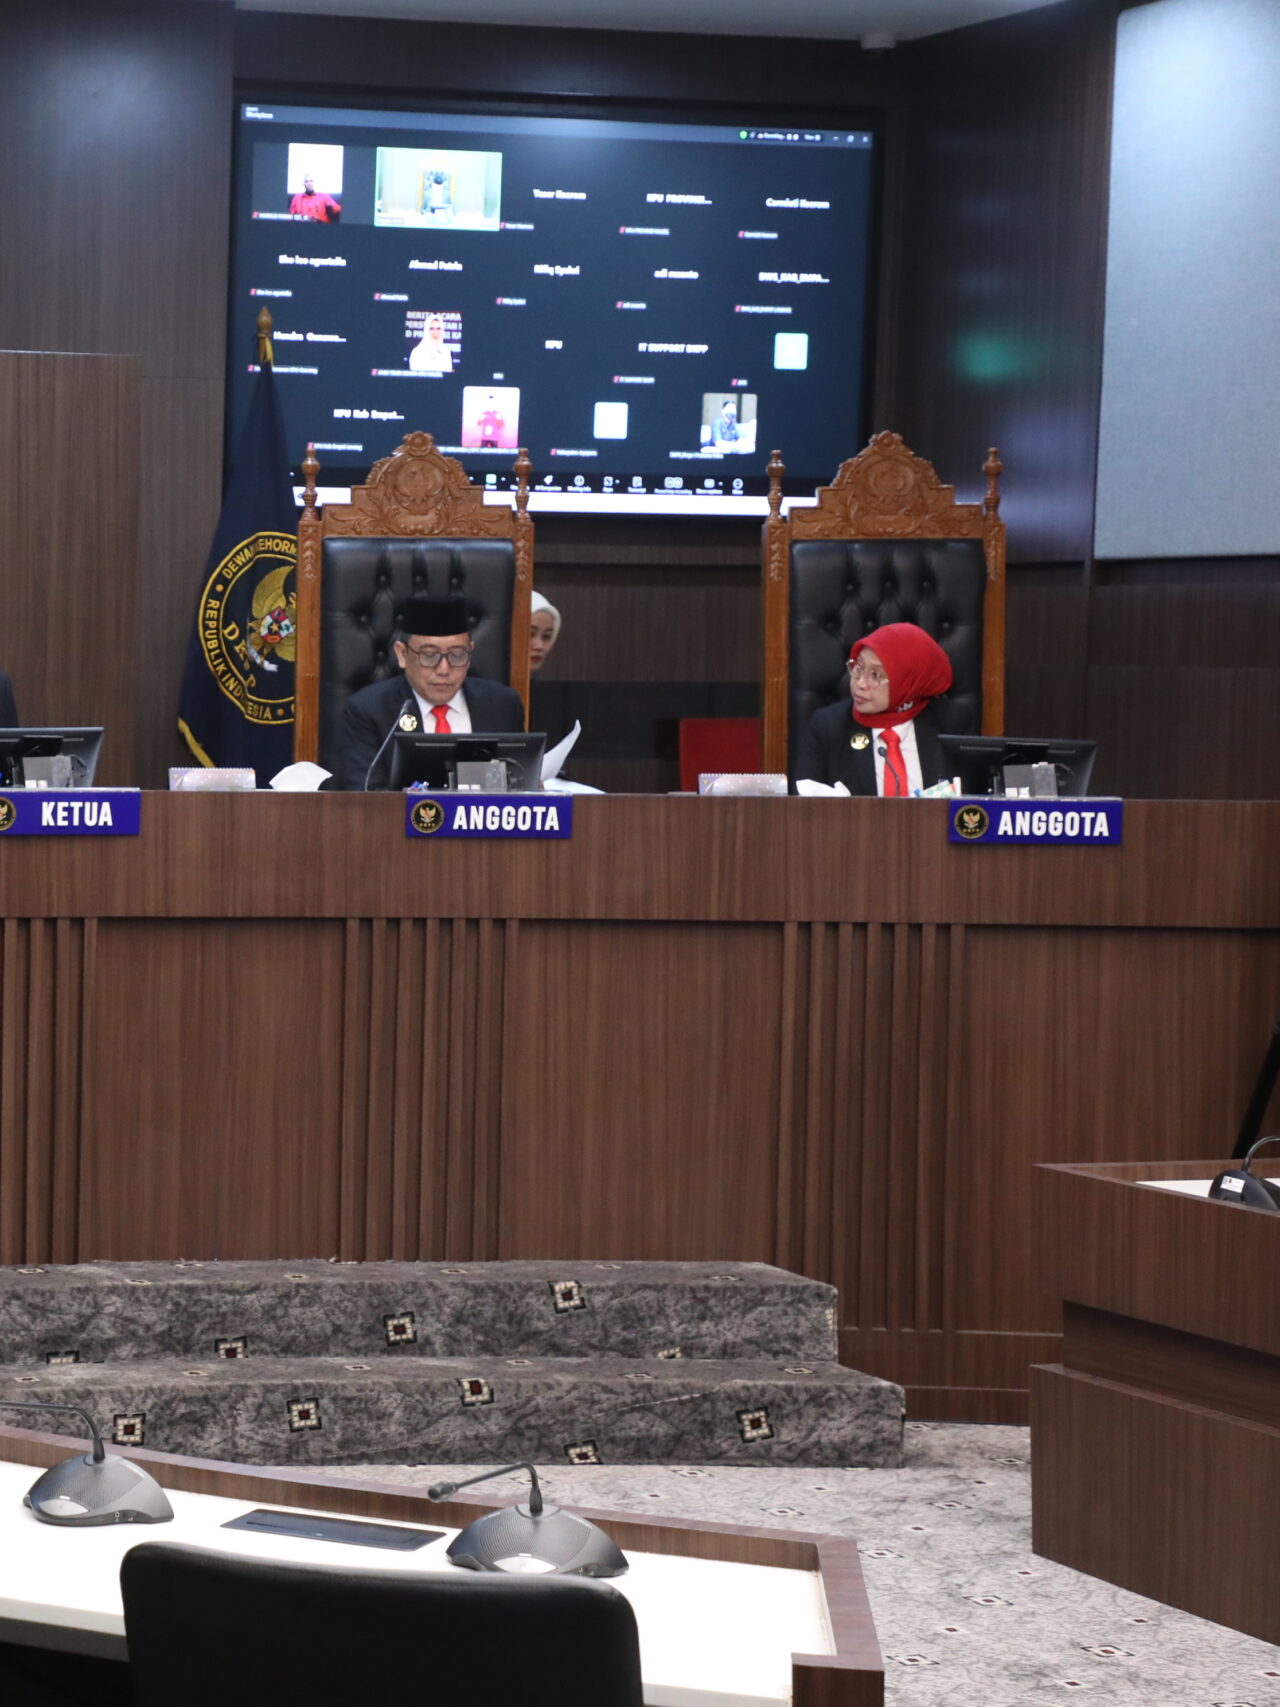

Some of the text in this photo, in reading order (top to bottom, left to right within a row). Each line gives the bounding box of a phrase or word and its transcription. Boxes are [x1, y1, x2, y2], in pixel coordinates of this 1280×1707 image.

[204, 599, 273, 720] REPUBLIK INDESIA
[41, 801, 114, 827] KETUA
[453, 805, 560, 831] ANGGOTA
[997, 811, 1109, 837] ANGGOTA
